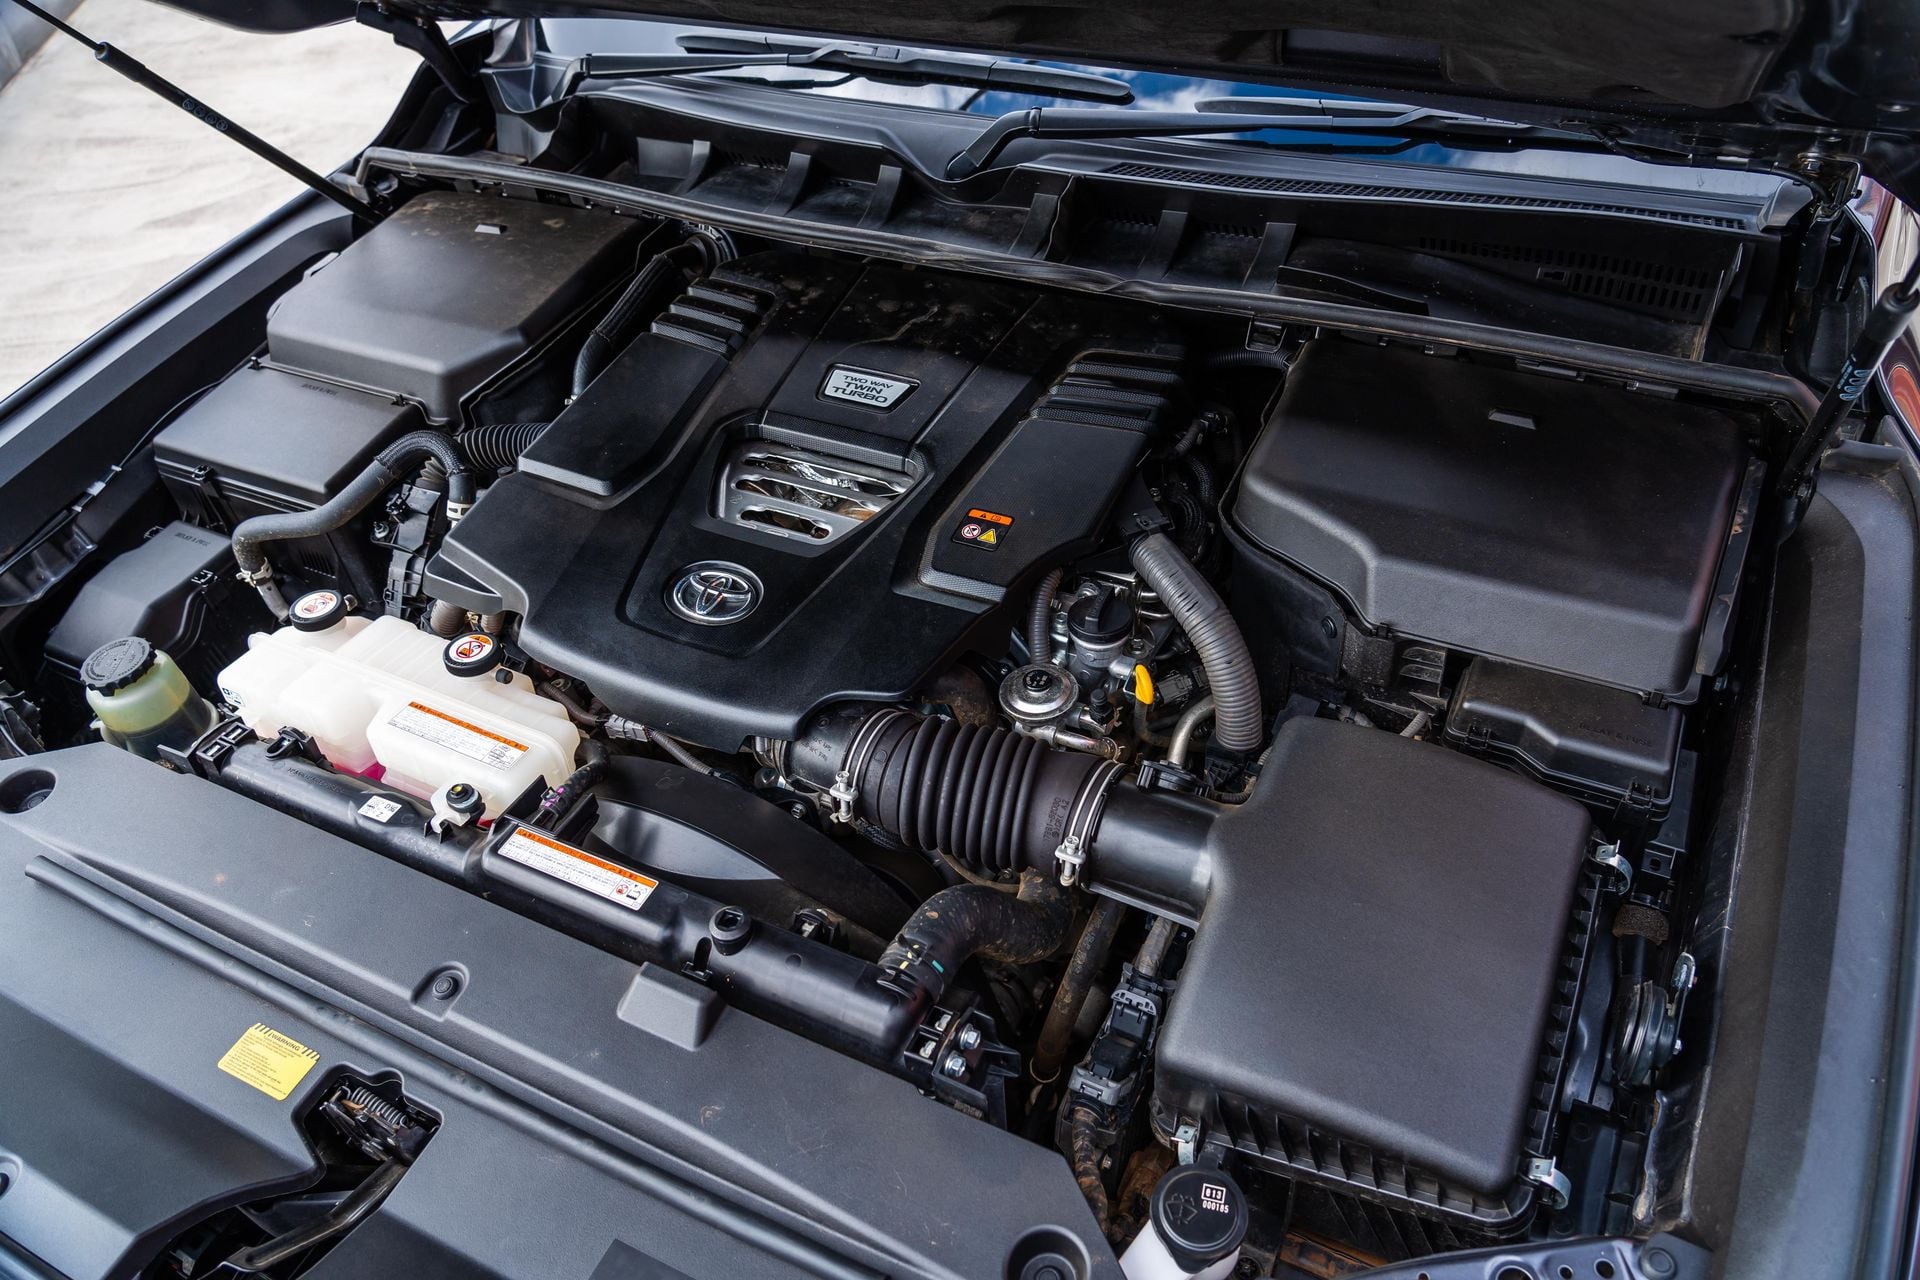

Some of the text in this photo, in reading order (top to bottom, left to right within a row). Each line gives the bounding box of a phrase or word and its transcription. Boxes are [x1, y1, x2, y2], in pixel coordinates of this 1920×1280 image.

[843, 375, 894, 389] TWO WAY
[844, 381, 883, 394] TWIN
[832, 386, 888, 403] TURBO
[270, 1032, 300, 1052] WARNING
[1202, 1200, 1229, 1214] 000185
